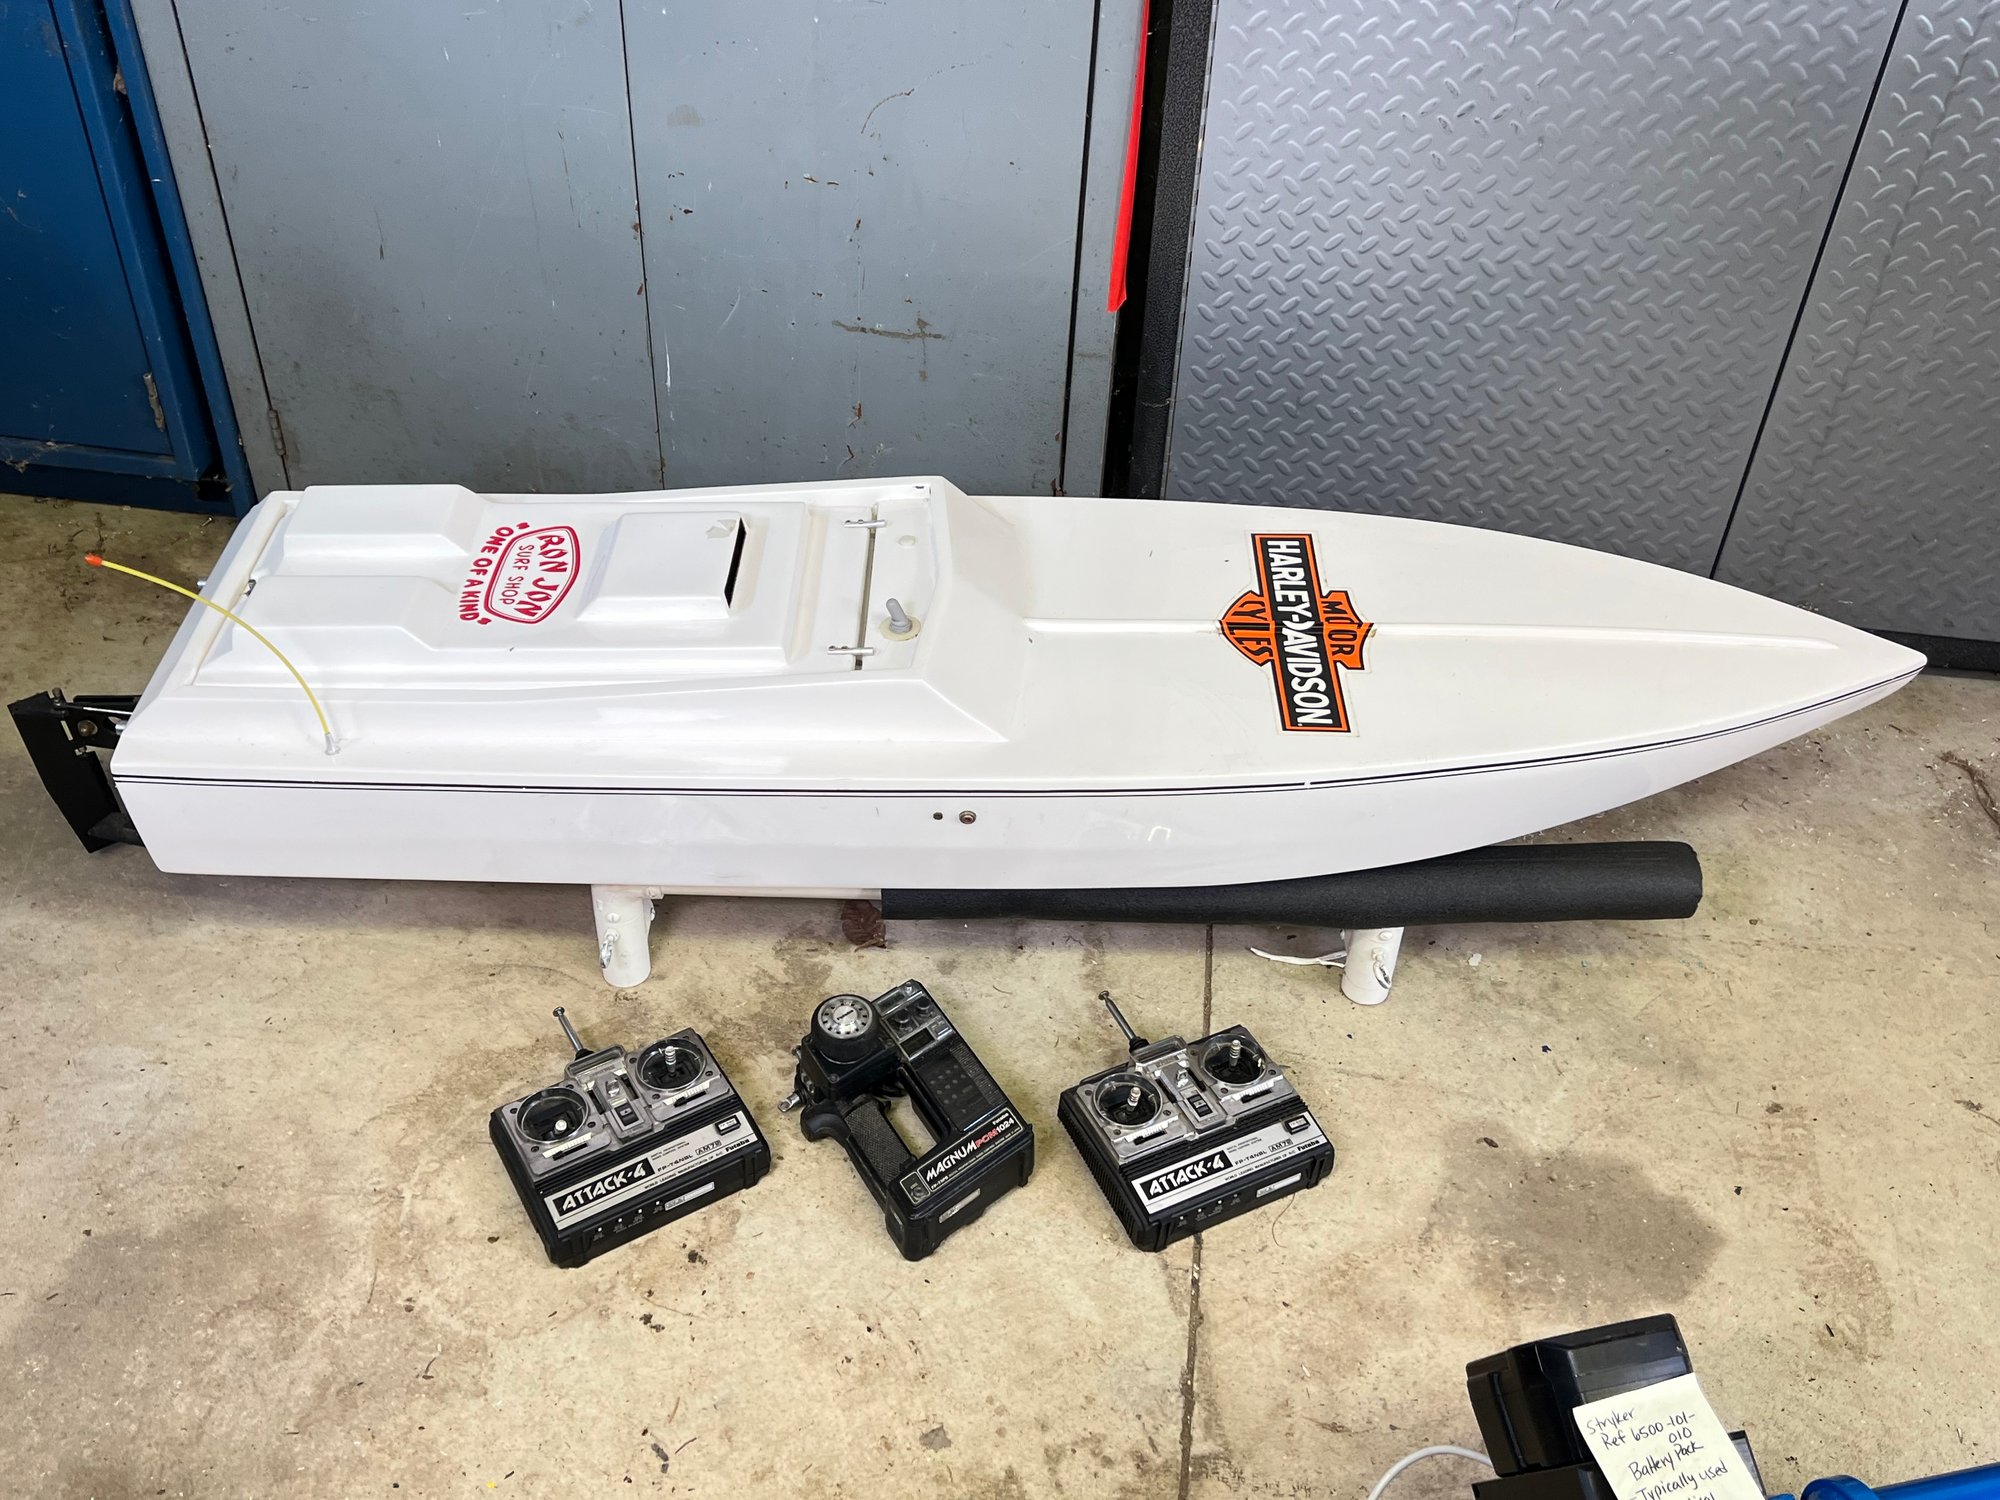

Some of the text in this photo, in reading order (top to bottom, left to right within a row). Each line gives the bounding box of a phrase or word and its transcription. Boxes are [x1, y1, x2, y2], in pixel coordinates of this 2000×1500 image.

[469, 557, 493, 576] OF
[499, 544, 535, 605] SURF SHOP
[513, 534, 569, 617] RON JON
[463, 579, 484, 588] A
[562, 1162, 647, 1211] ATTACK-4
[1149, 1154, 1225, 1196] ATTACK-4
[1586, 1407, 1635, 1435] Stryker
[1668, 1427, 1693, 1443] 010
[1600, 1430, 1626, 1450] Ref
[1628, 1441, 1704, 1482] Battery Pack
[1699, 1459, 1728, 1480] used
